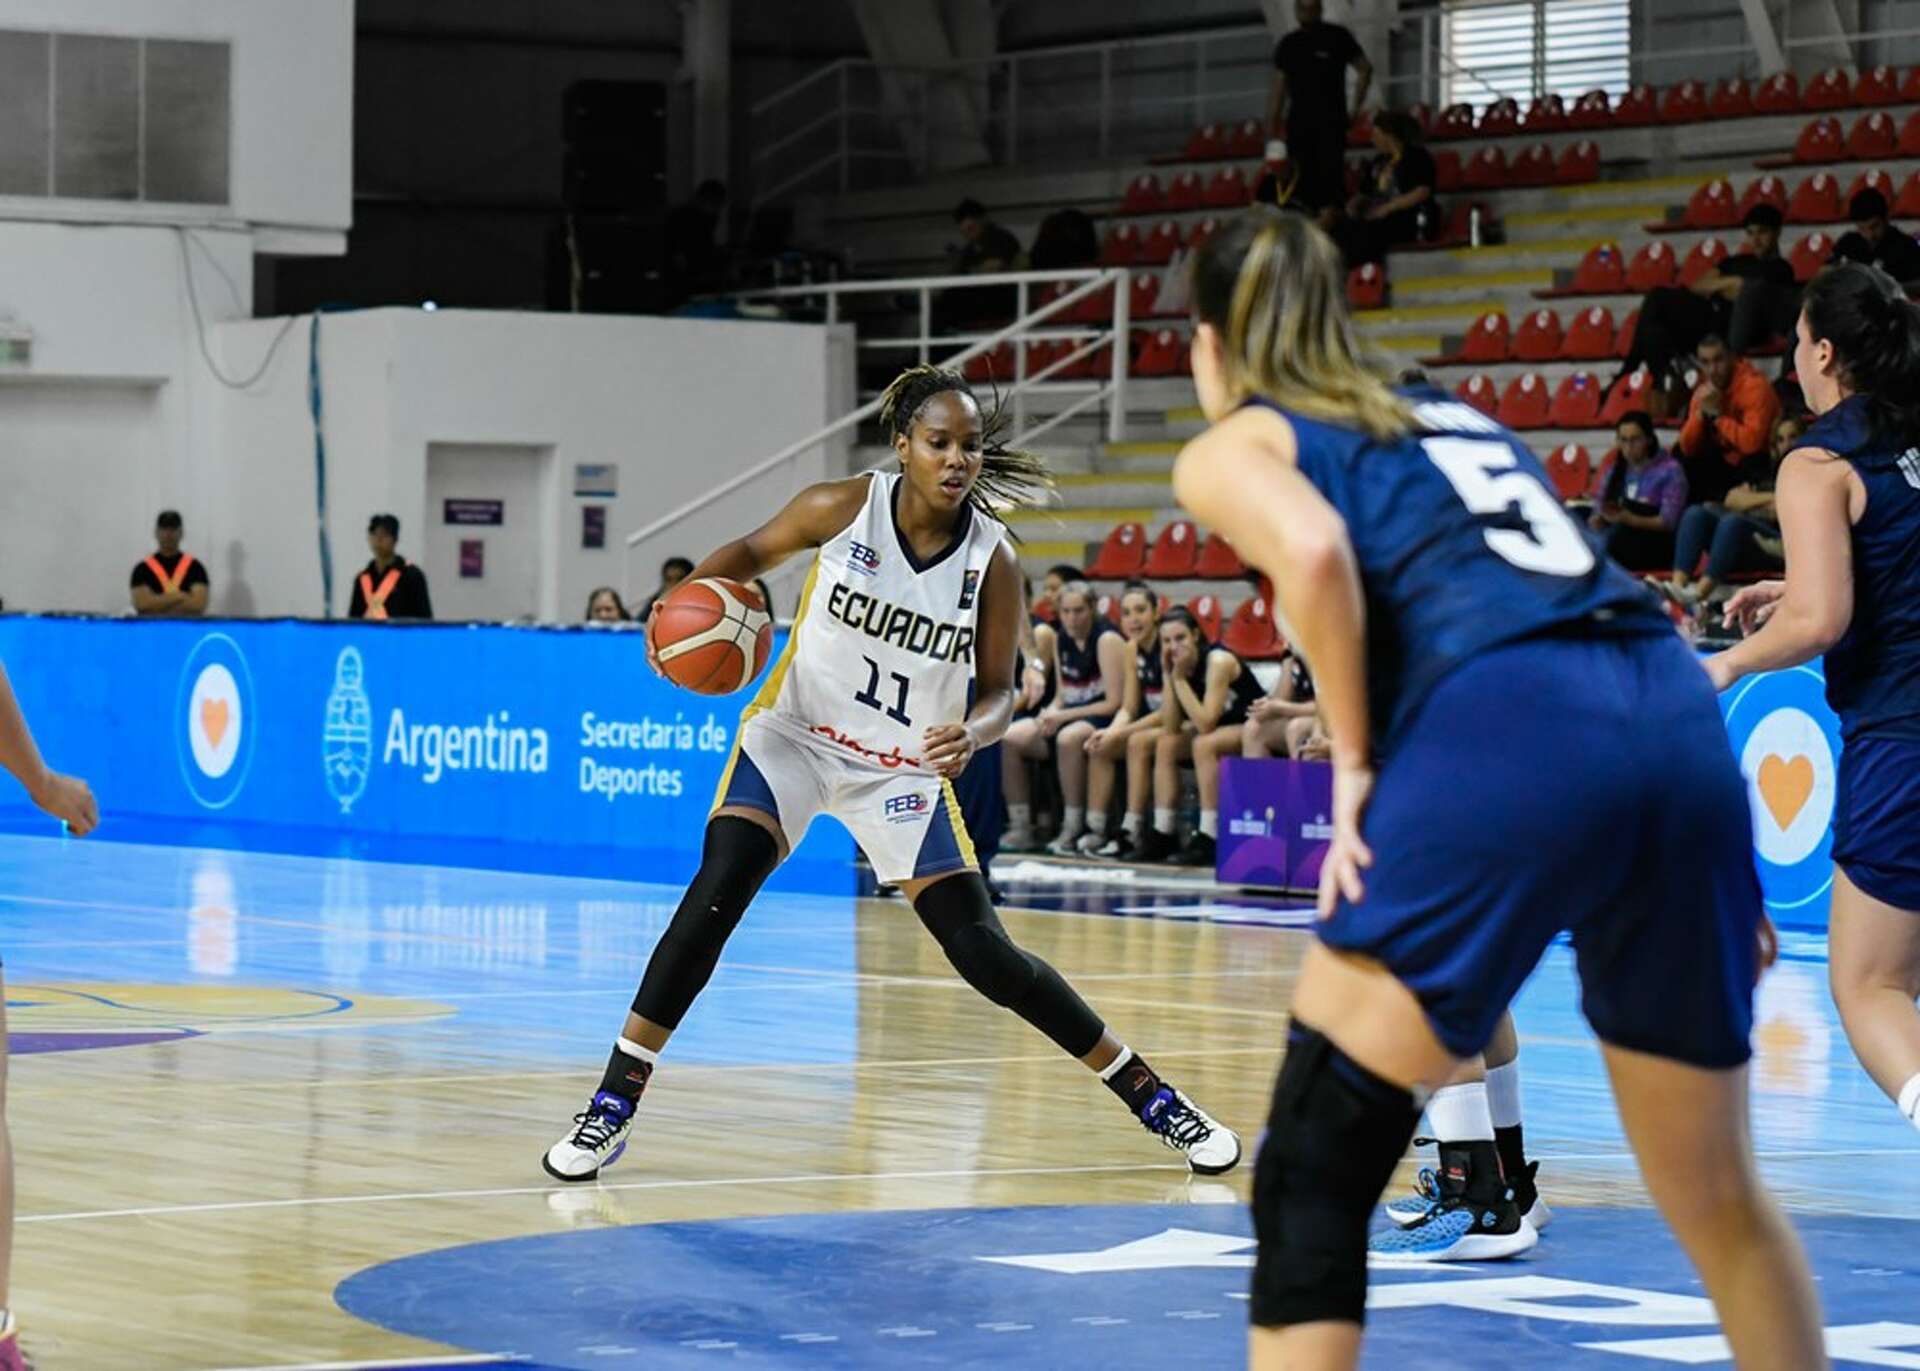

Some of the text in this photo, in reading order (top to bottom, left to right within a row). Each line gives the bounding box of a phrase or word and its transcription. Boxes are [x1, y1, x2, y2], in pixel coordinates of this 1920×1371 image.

[1420, 436, 1596, 577] 5
[828, 582, 974, 664] ECUADOR
[855, 654, 911, 727] 11
[384, 708, 548, 783] Argentina
[580, 711, 727, 753] Secretaría de
[579, 758, 683, 802] Deportes
